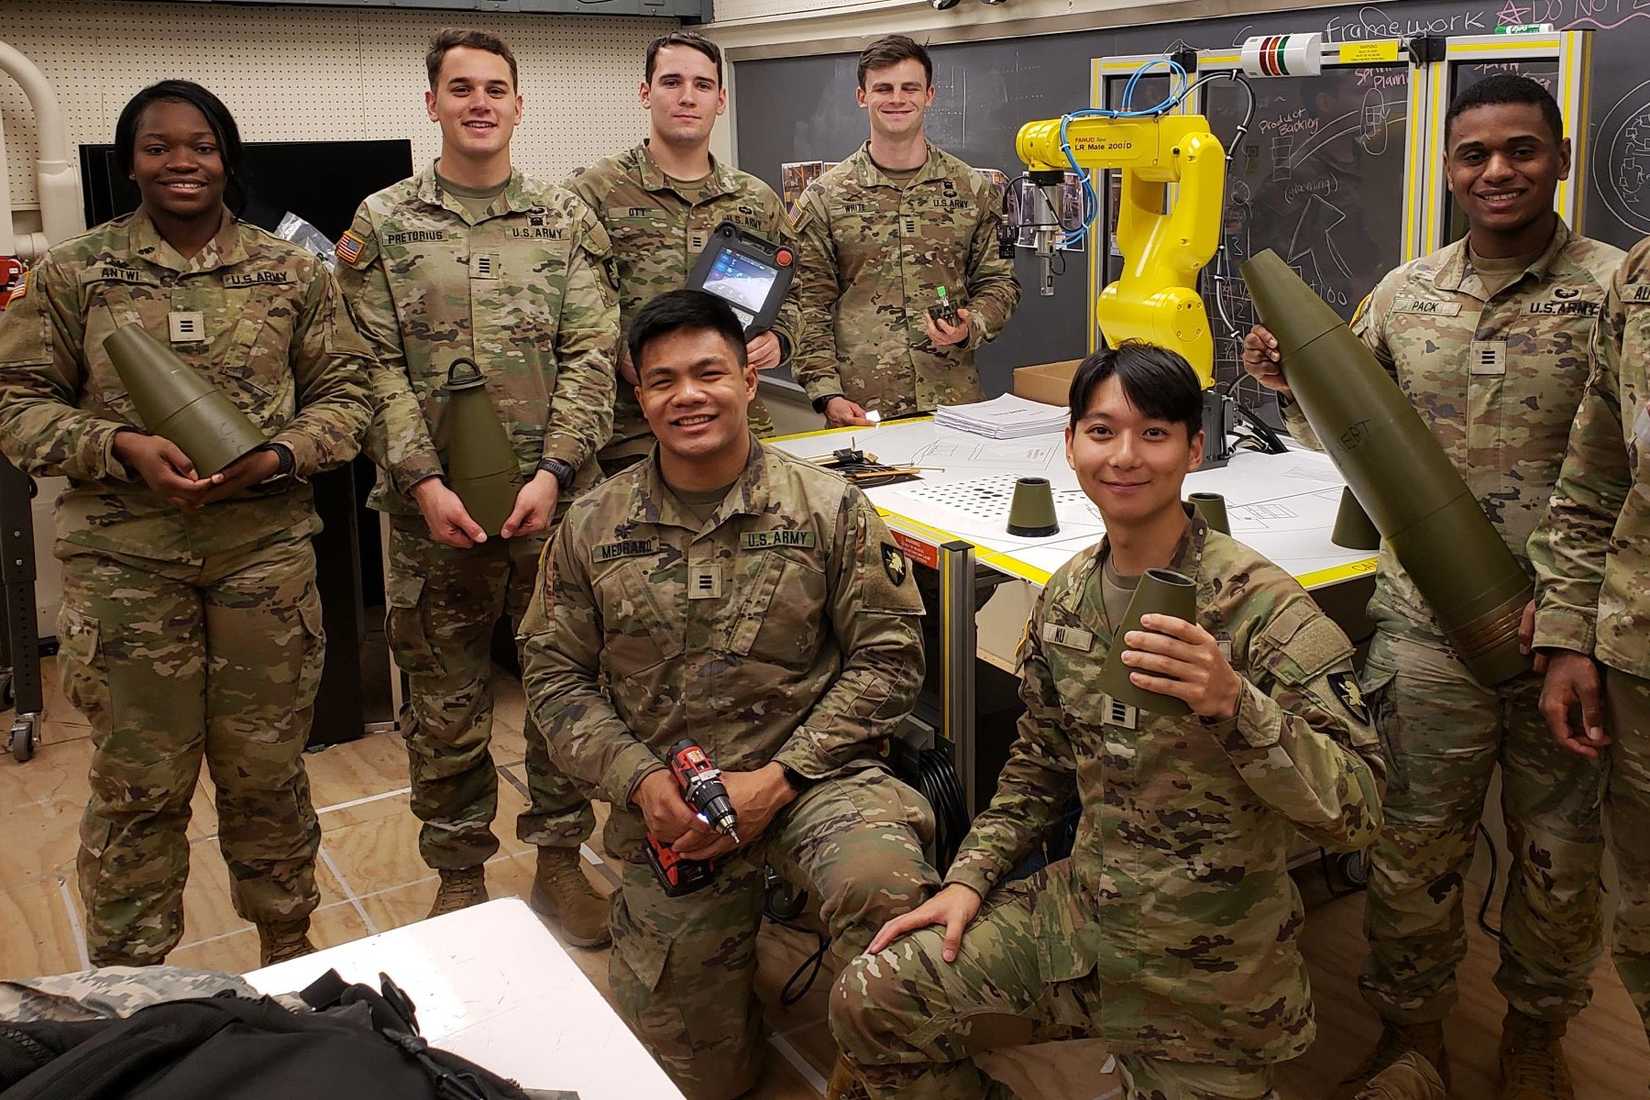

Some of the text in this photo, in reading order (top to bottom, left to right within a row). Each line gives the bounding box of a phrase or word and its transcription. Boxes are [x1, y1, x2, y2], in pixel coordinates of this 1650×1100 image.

[628, 208, 646, 216] OTT
[388, 231, 443, 244] PRETORIUS
[535, 229, 562, 239] ARMY
[101, 268, 140, 281] ANTWI
[256, 272, 288, 283] ARMY
[1411, 301, 1438, 312] PACK
[772, 531, 808, 545] ARMY
